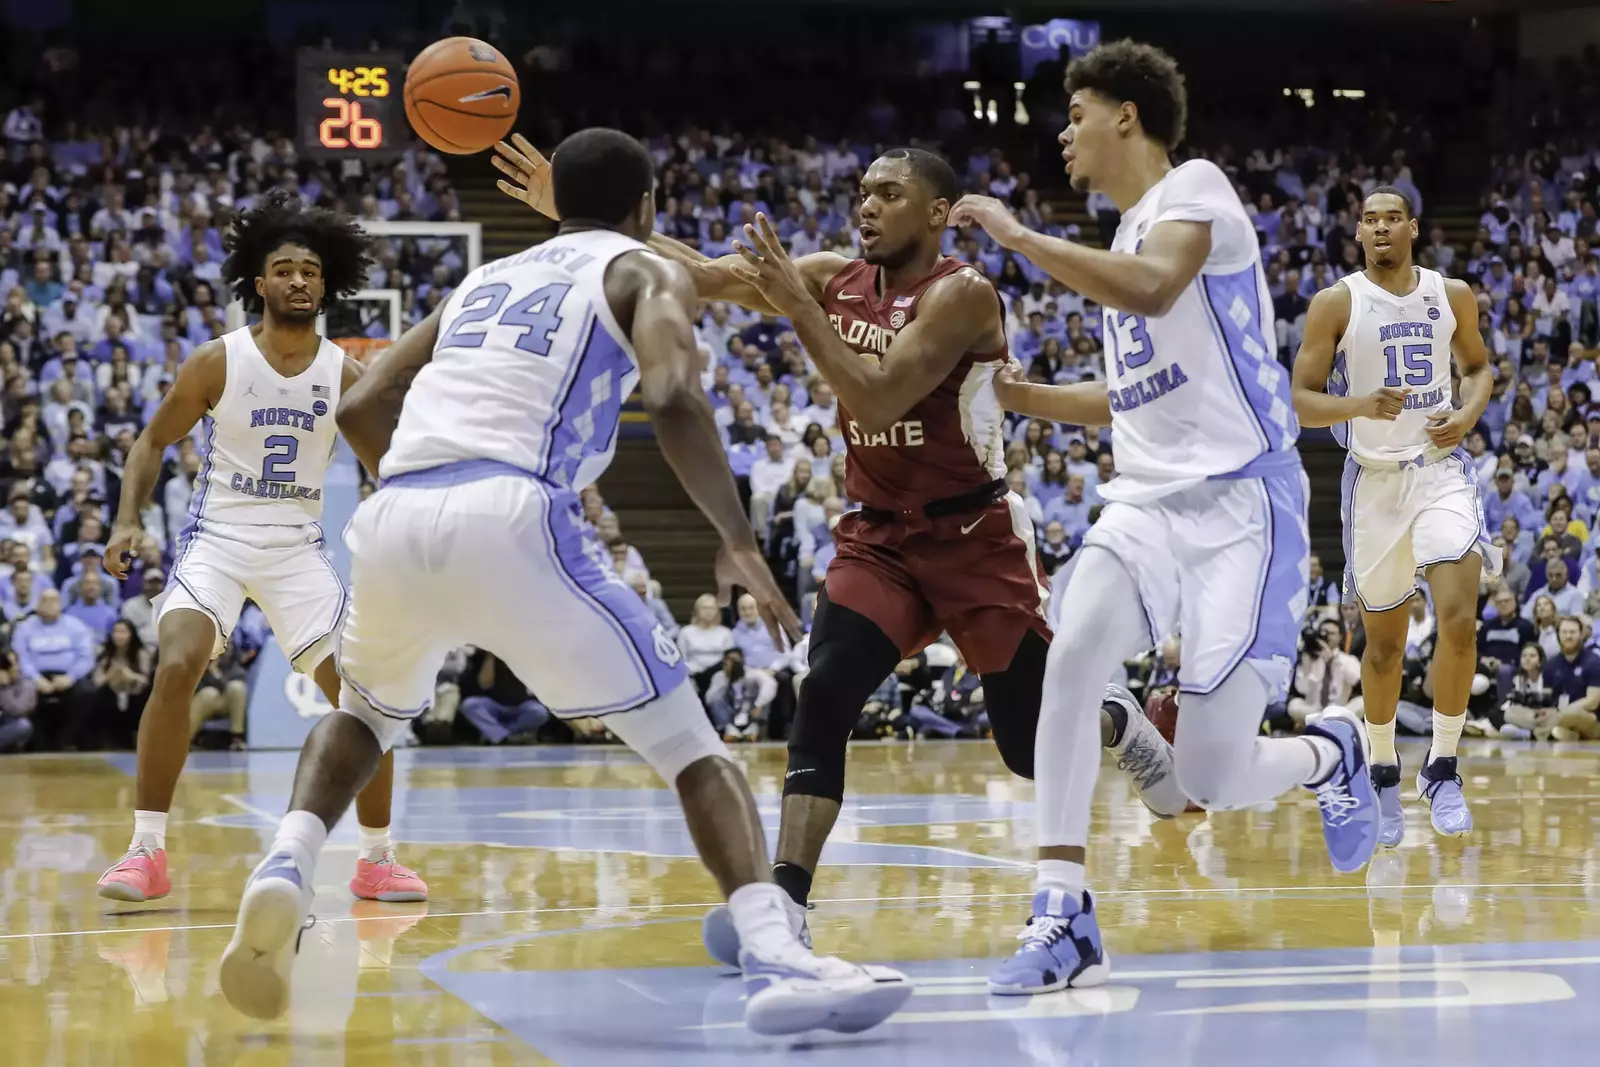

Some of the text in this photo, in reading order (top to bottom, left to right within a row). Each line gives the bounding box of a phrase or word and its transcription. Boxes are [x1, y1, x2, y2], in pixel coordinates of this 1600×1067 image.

[328, 66, 390, 97] 4:25
[319, 97, 383, 149] 26
[436, 282, 575, 358] 24
[1379, 321, 1434, 342] NORTH
[1107, 362, 1189, 412] CROLINA
[1383, 343, 1433, 387] 15
[250, 407, 316, 432] NORTH
[1401, 387, 1445, 410] OLINA
[261, 434, 299, 482] 2
